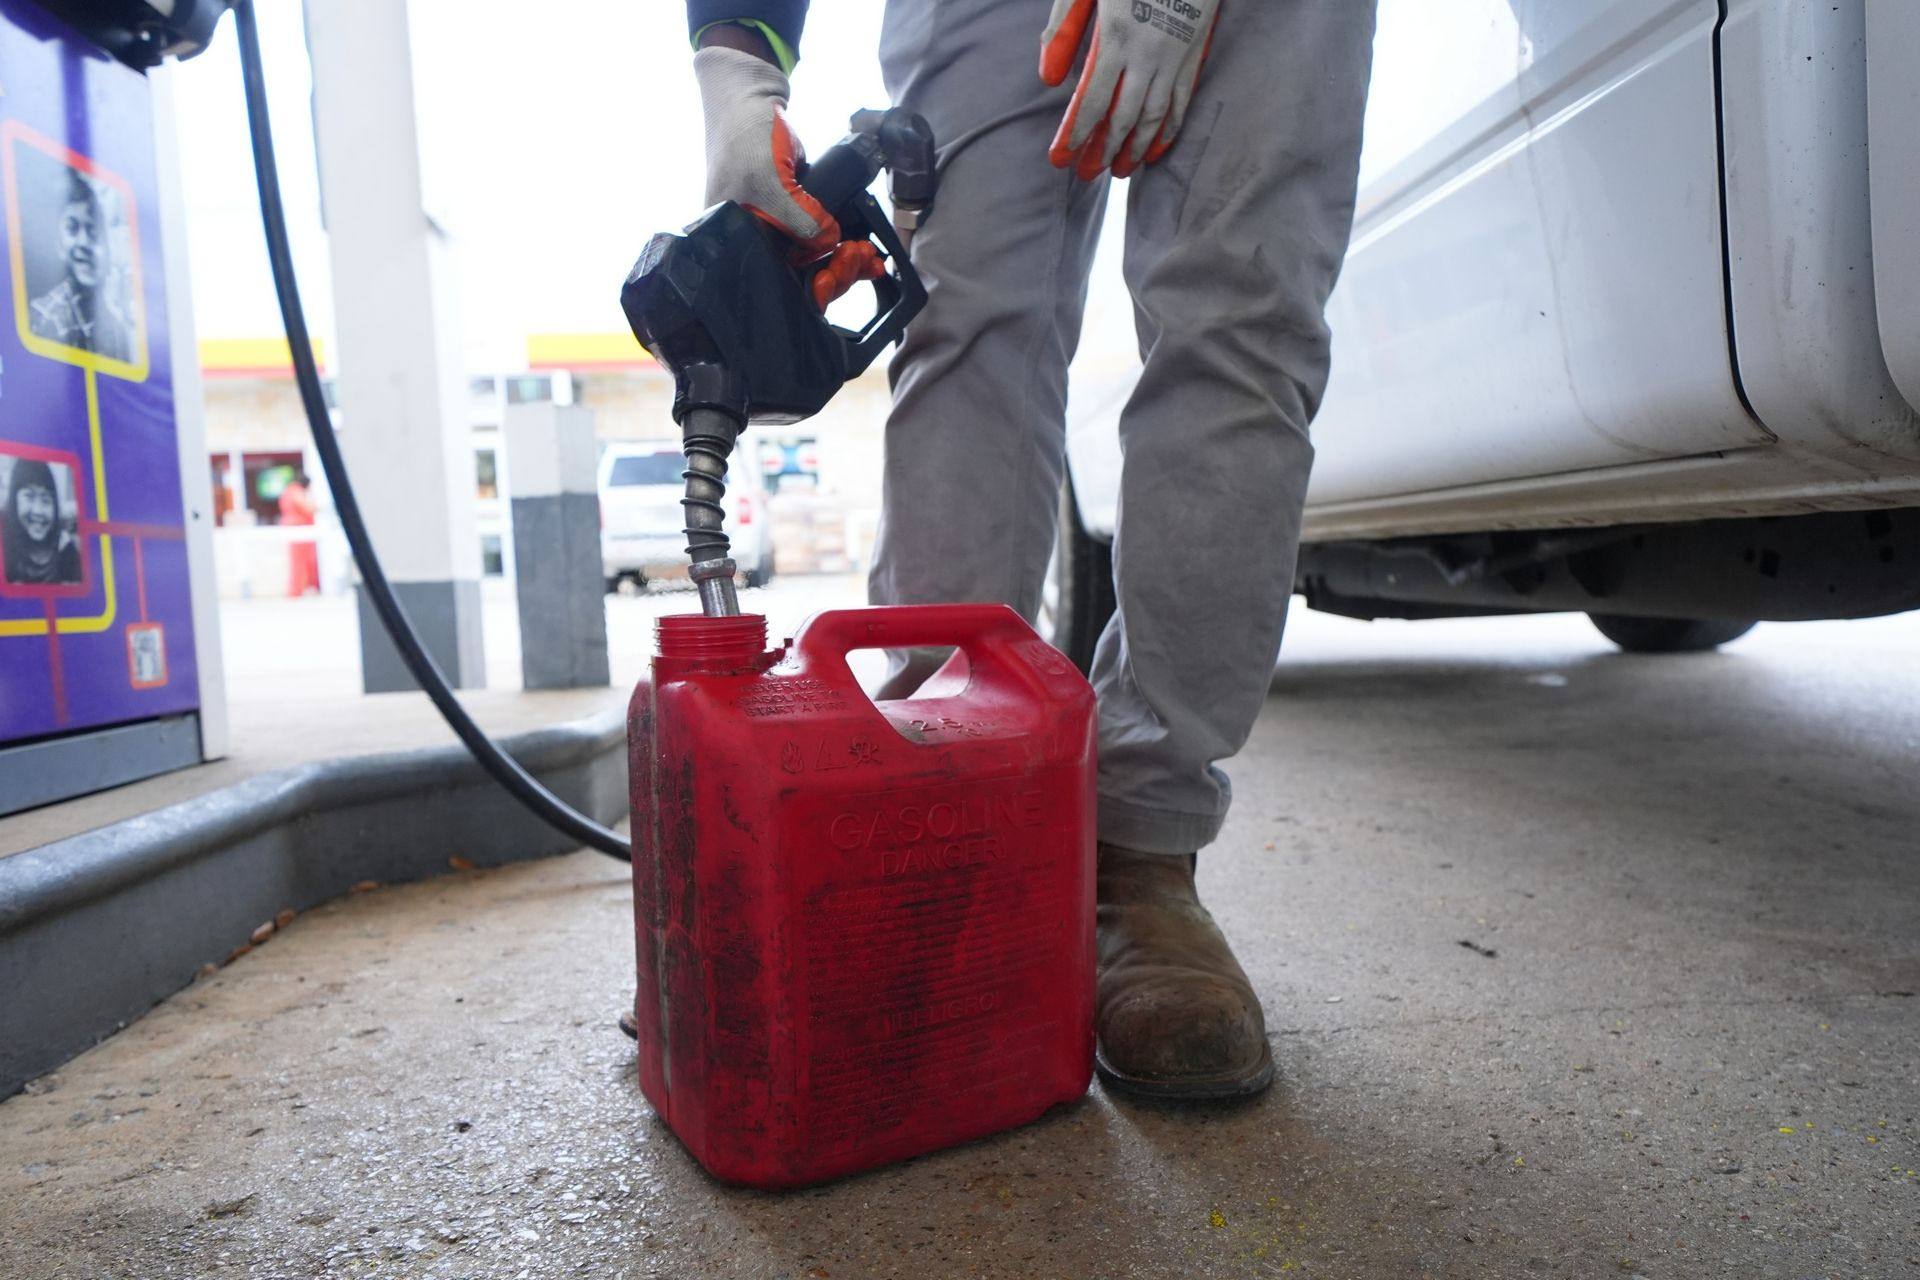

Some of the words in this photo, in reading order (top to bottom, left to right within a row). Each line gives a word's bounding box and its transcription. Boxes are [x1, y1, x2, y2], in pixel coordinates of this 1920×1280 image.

[1133, 3, 1151, 19] A1
[1173, 0, 1202, 20] GRIP
[741, 691, 817, 704] GASOLINE
[745, 703, 795, 717] START
[830, 790, 1044, 850] GASOLINE
